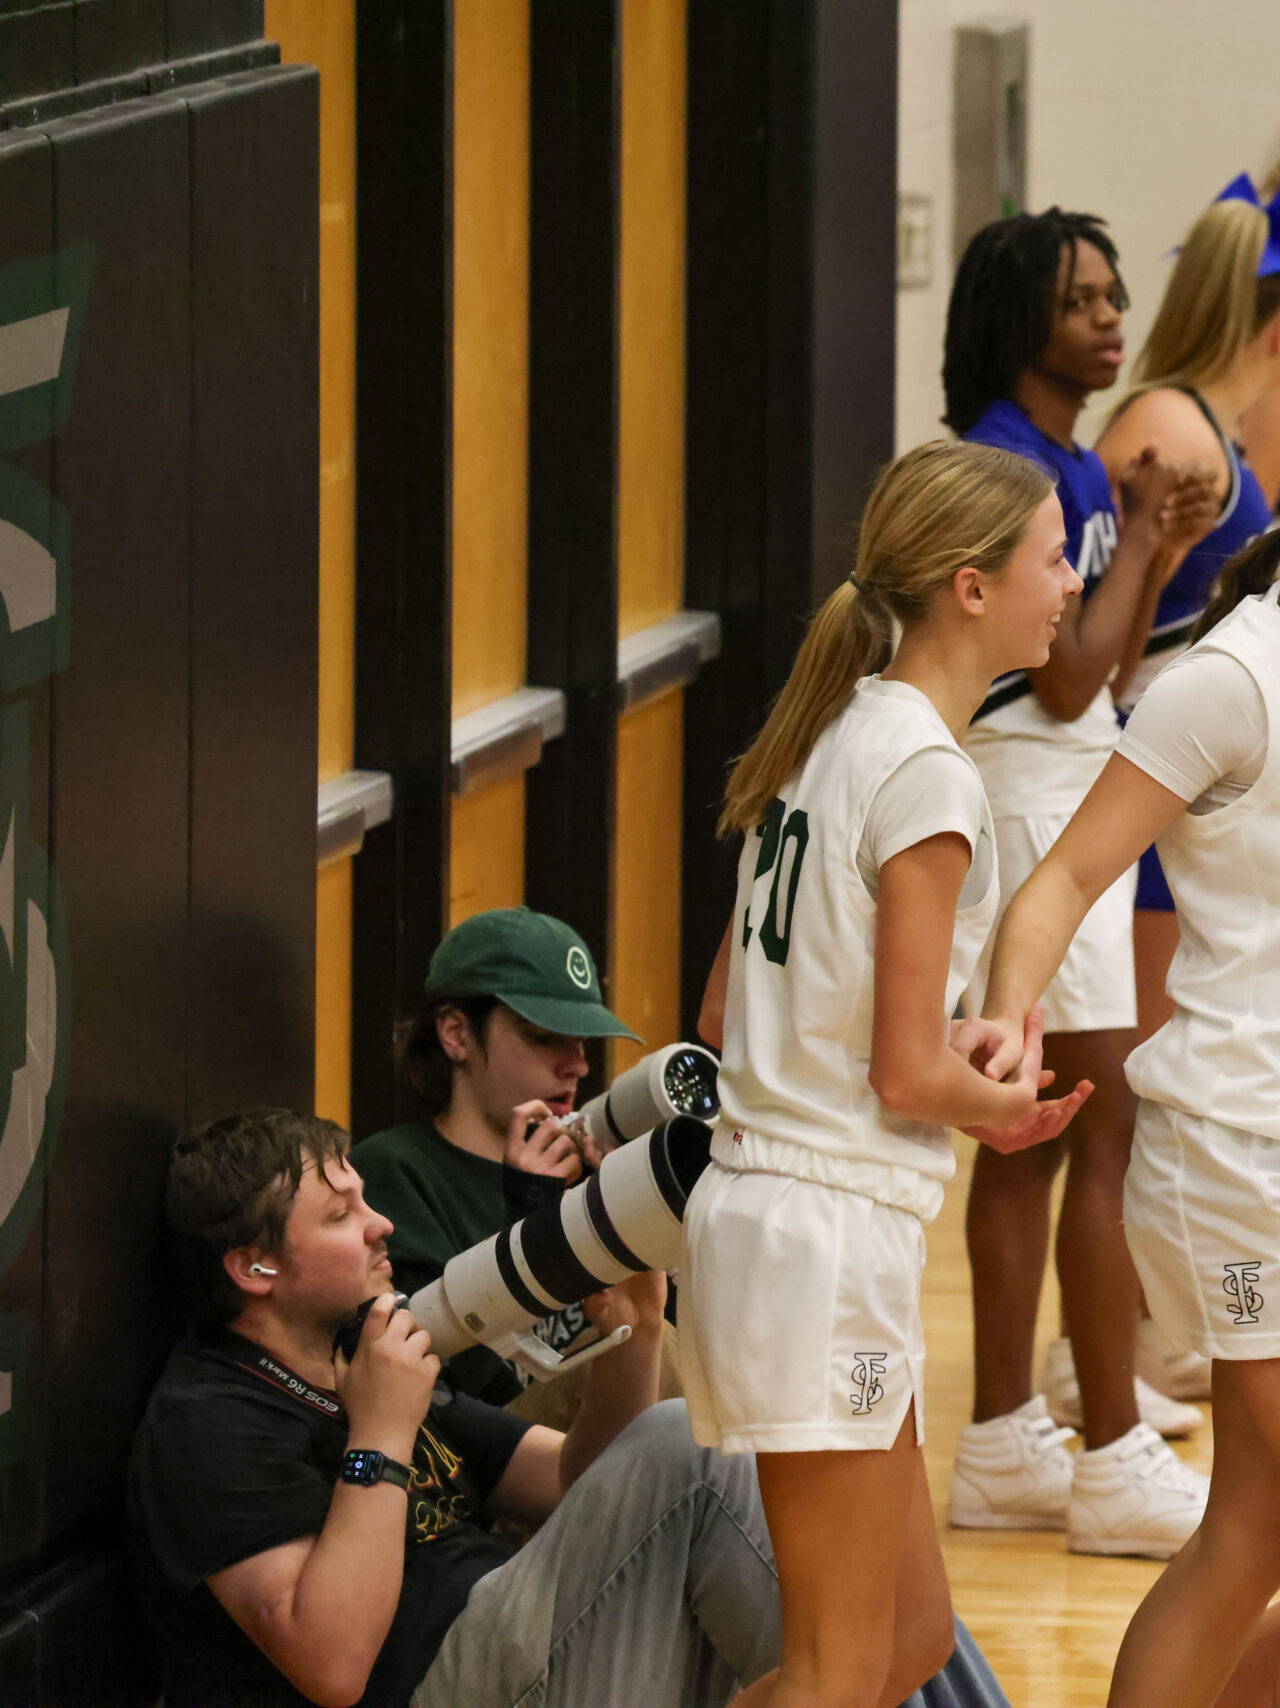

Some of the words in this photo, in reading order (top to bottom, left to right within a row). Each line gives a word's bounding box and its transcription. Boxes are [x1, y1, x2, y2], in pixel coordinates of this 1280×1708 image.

[267, 1361, 290, 1381] Mark
[287, 1378, 307, 1396] R6
[304, 1391, 339, 1413] EOS
